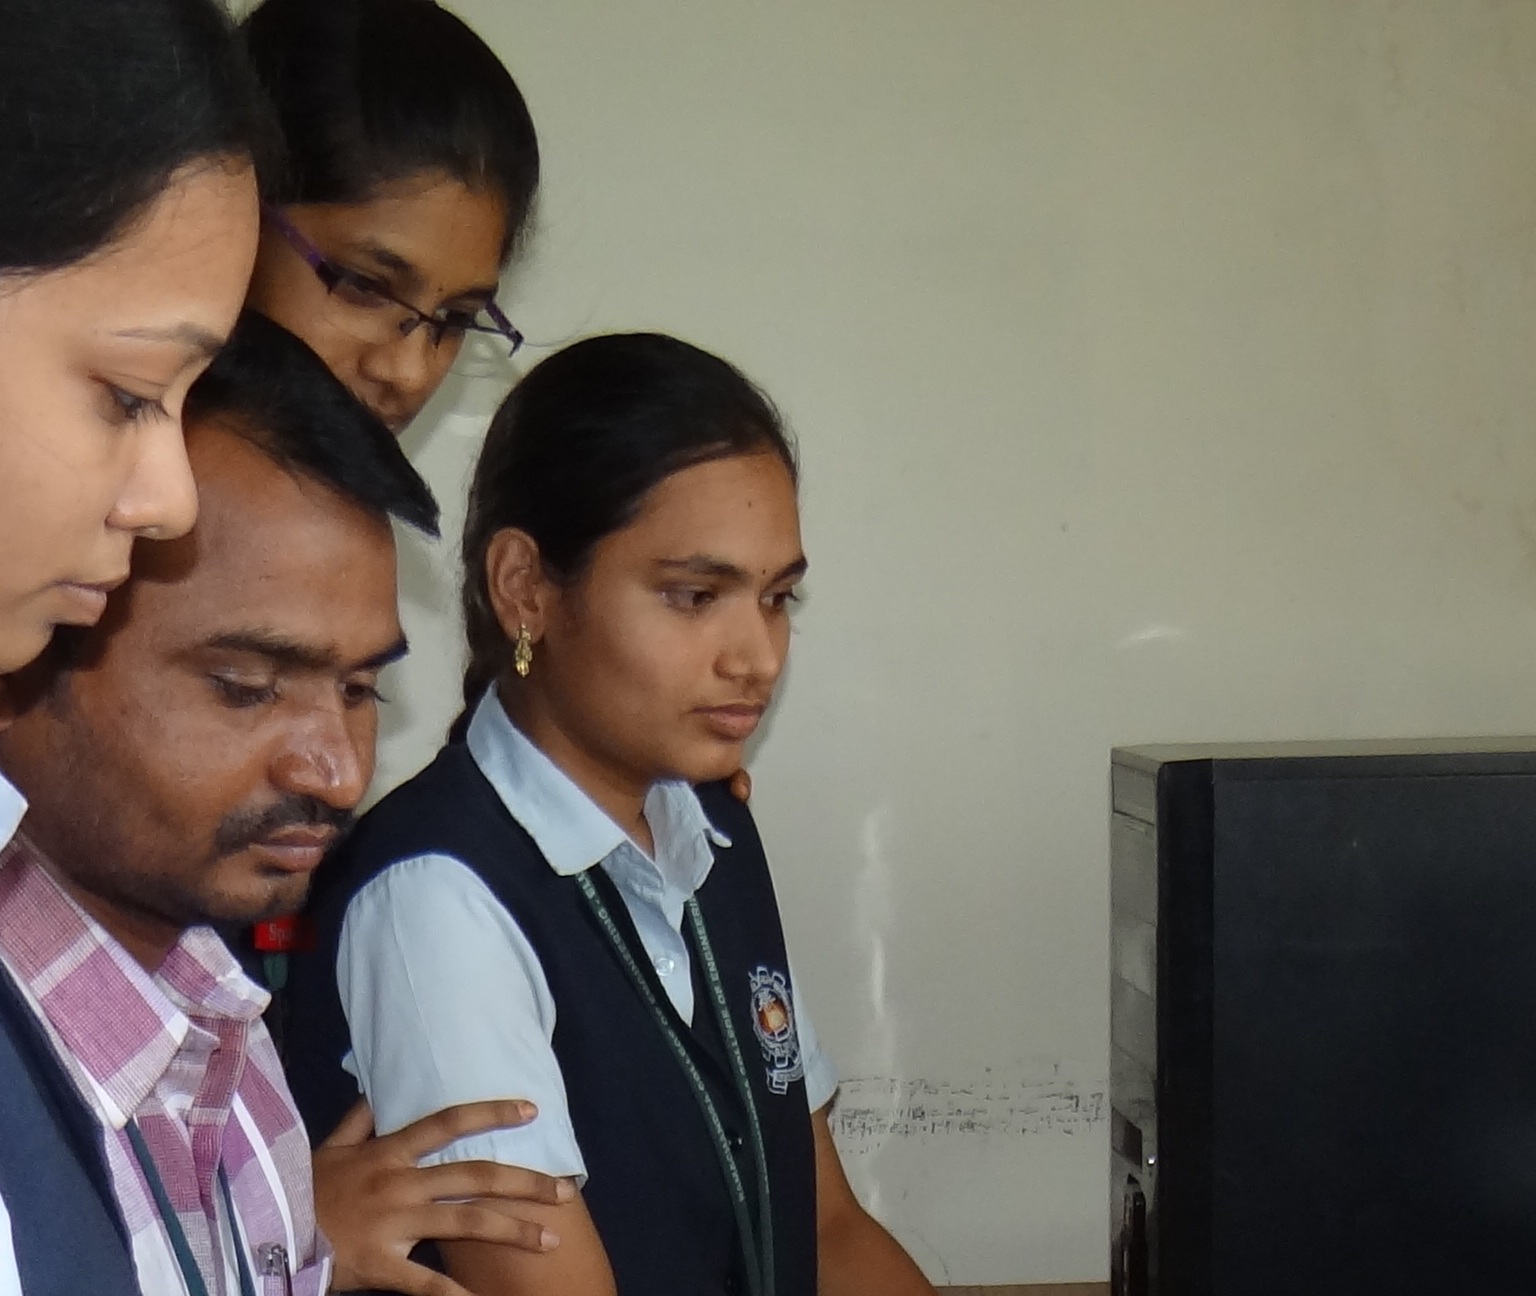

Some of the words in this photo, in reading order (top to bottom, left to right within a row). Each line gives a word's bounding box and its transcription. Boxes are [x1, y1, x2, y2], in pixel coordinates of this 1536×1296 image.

[595, 907, 657, 1004] ENGINEERING
[714, 985, 726, 1004] OF
[667, 1028, 706, 1091] COLLEGE
[721, 1010, 747, 1075] COLLEGE
